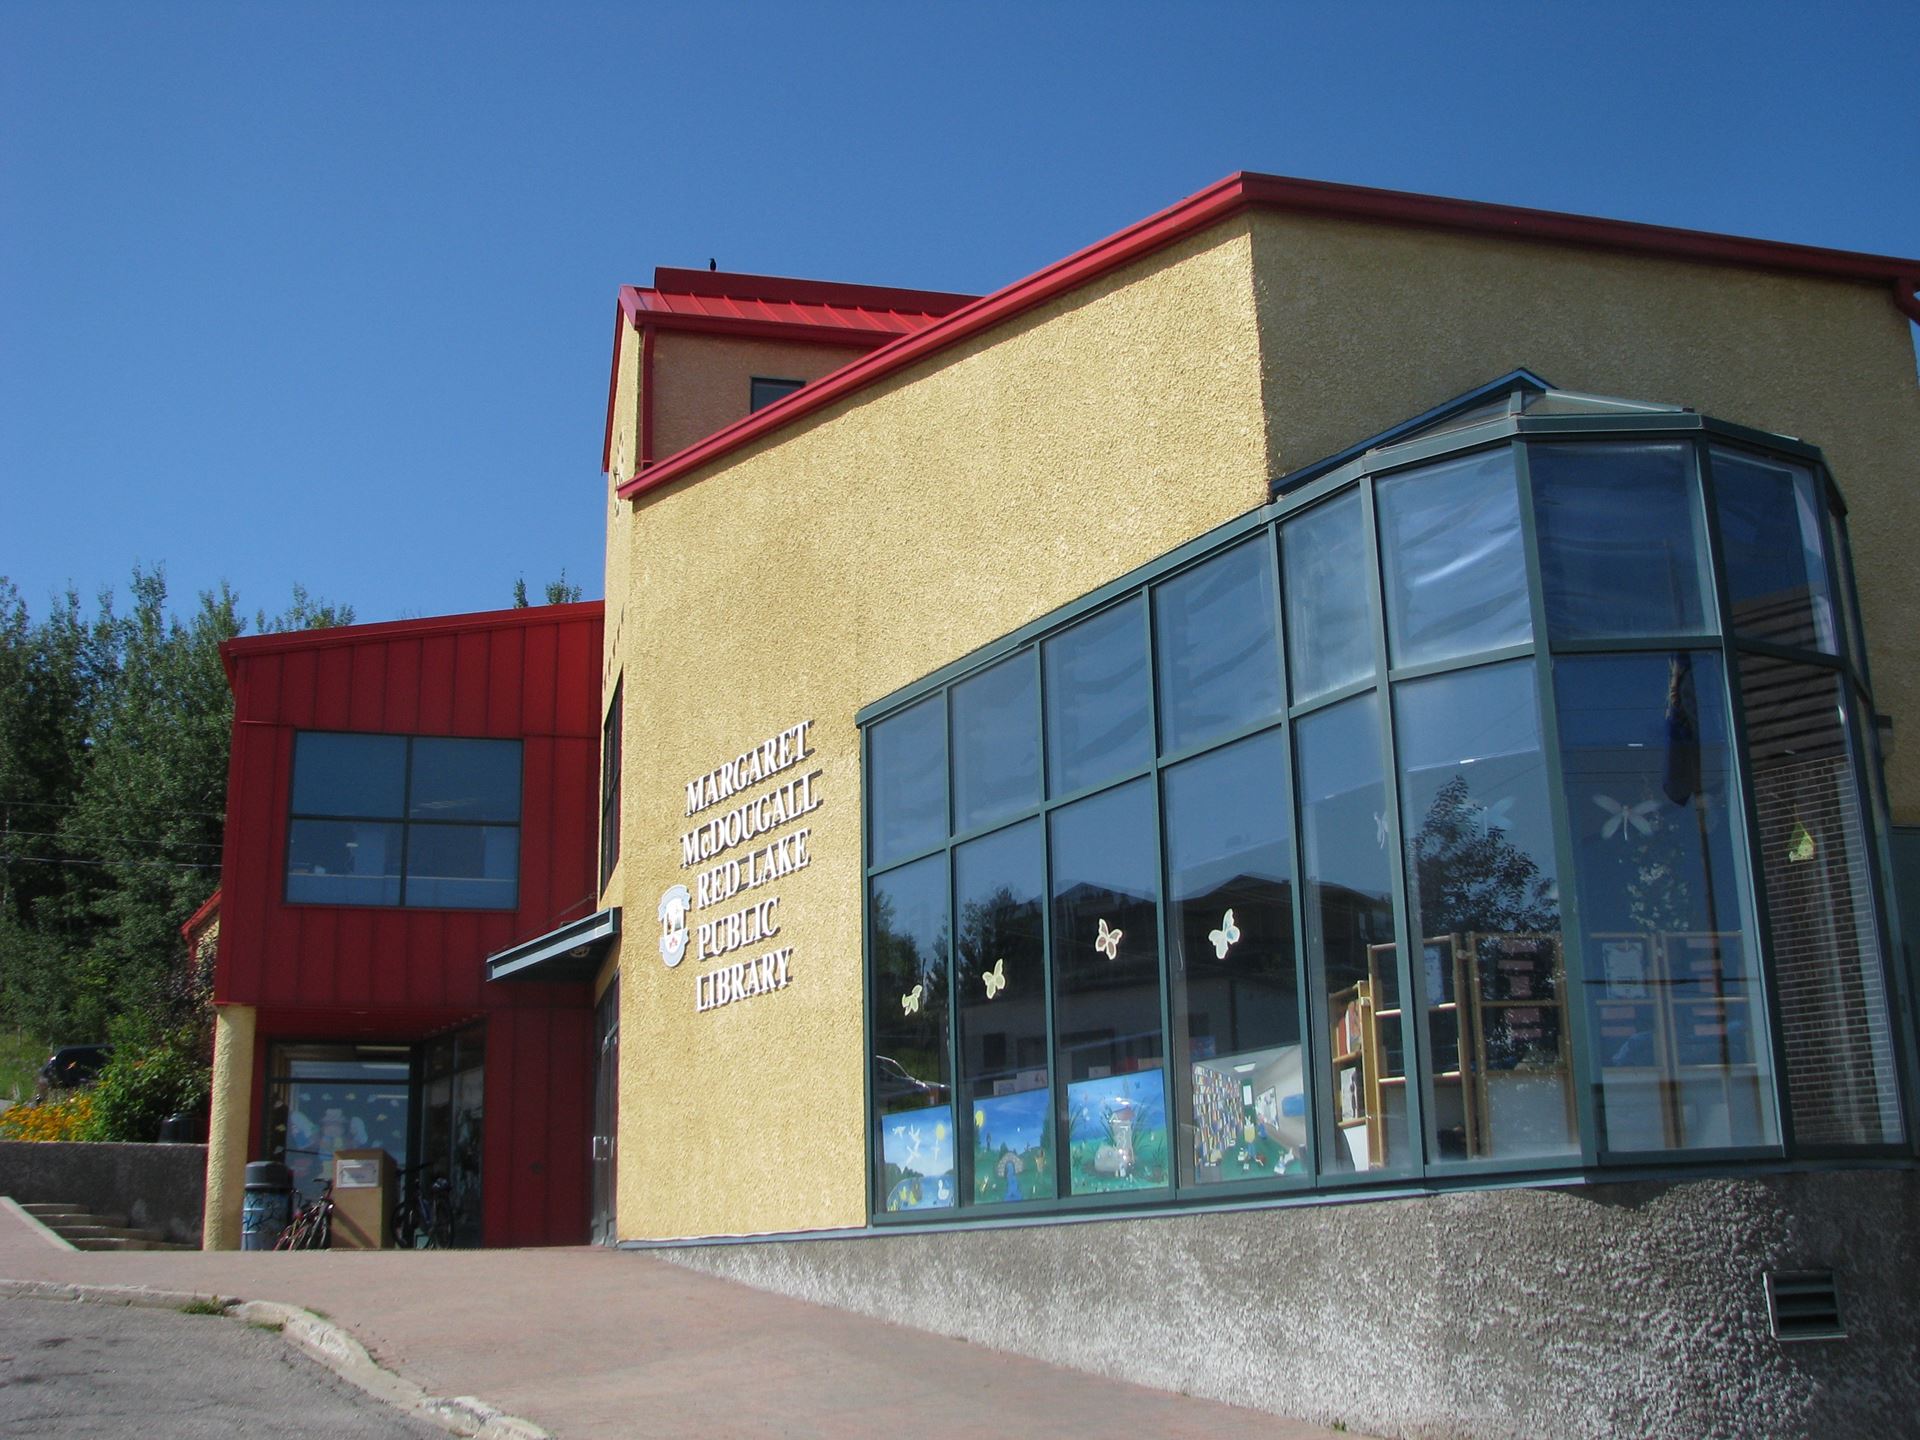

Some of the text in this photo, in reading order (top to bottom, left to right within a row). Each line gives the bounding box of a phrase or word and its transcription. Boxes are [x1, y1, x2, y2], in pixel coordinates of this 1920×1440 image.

[686, 720, 811, 816] MARGARET
[681, 772, 819, 868] McDOUGALL
[697, 828, 811, 909] RED LAKE
[697, 897, 779, 960] PUBLIC
[696, 948, 792, 1011] LIBRARY
